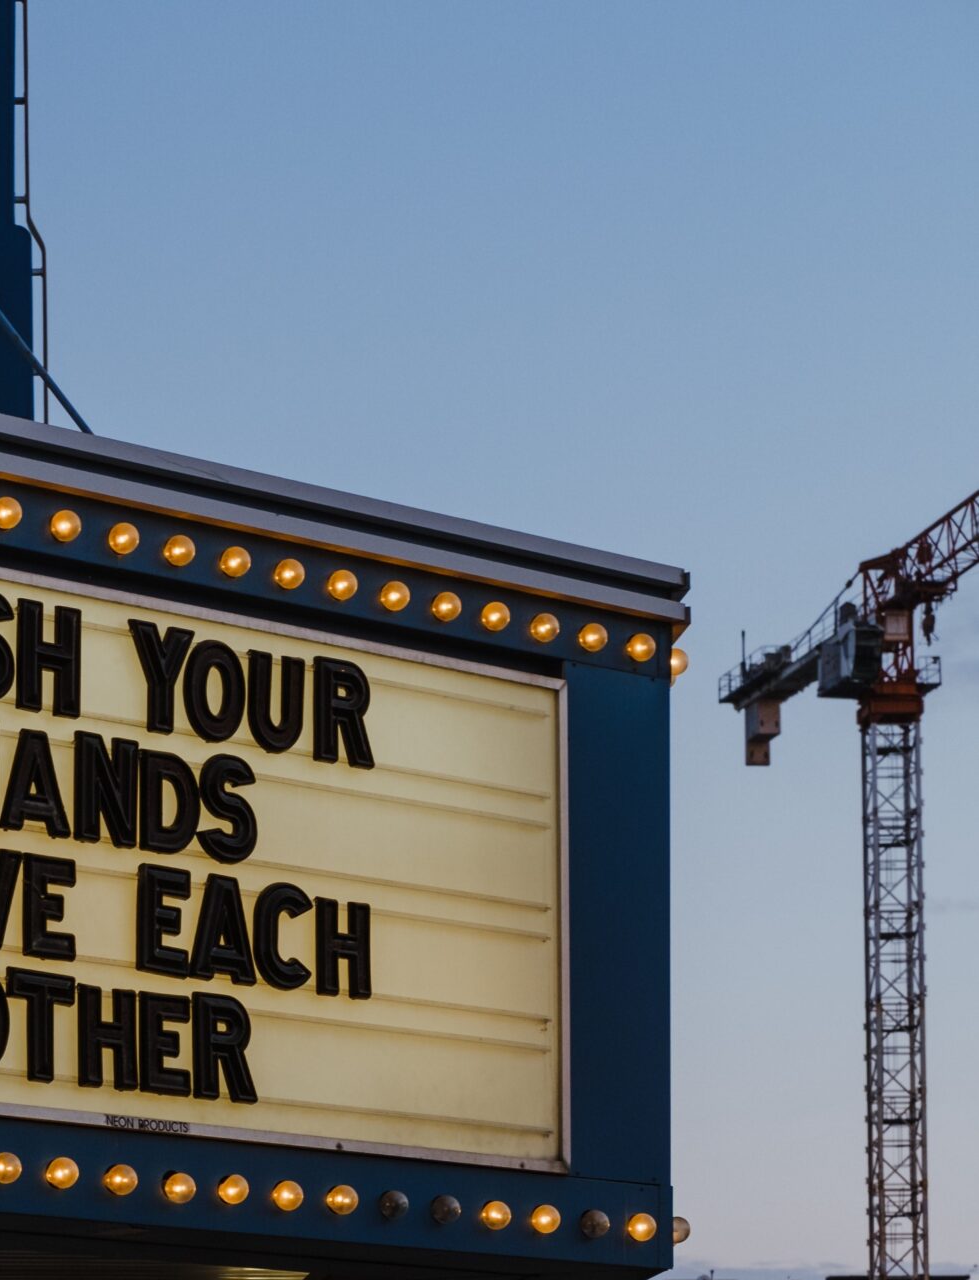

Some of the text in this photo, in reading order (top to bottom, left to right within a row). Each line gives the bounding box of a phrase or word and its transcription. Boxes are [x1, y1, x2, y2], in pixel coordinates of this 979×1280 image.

[127, 618, 375, 769] YOUR
[135, 862, 372, 999] EACH
[104, 1114, 191, 1133] NEON PRODUCTS
